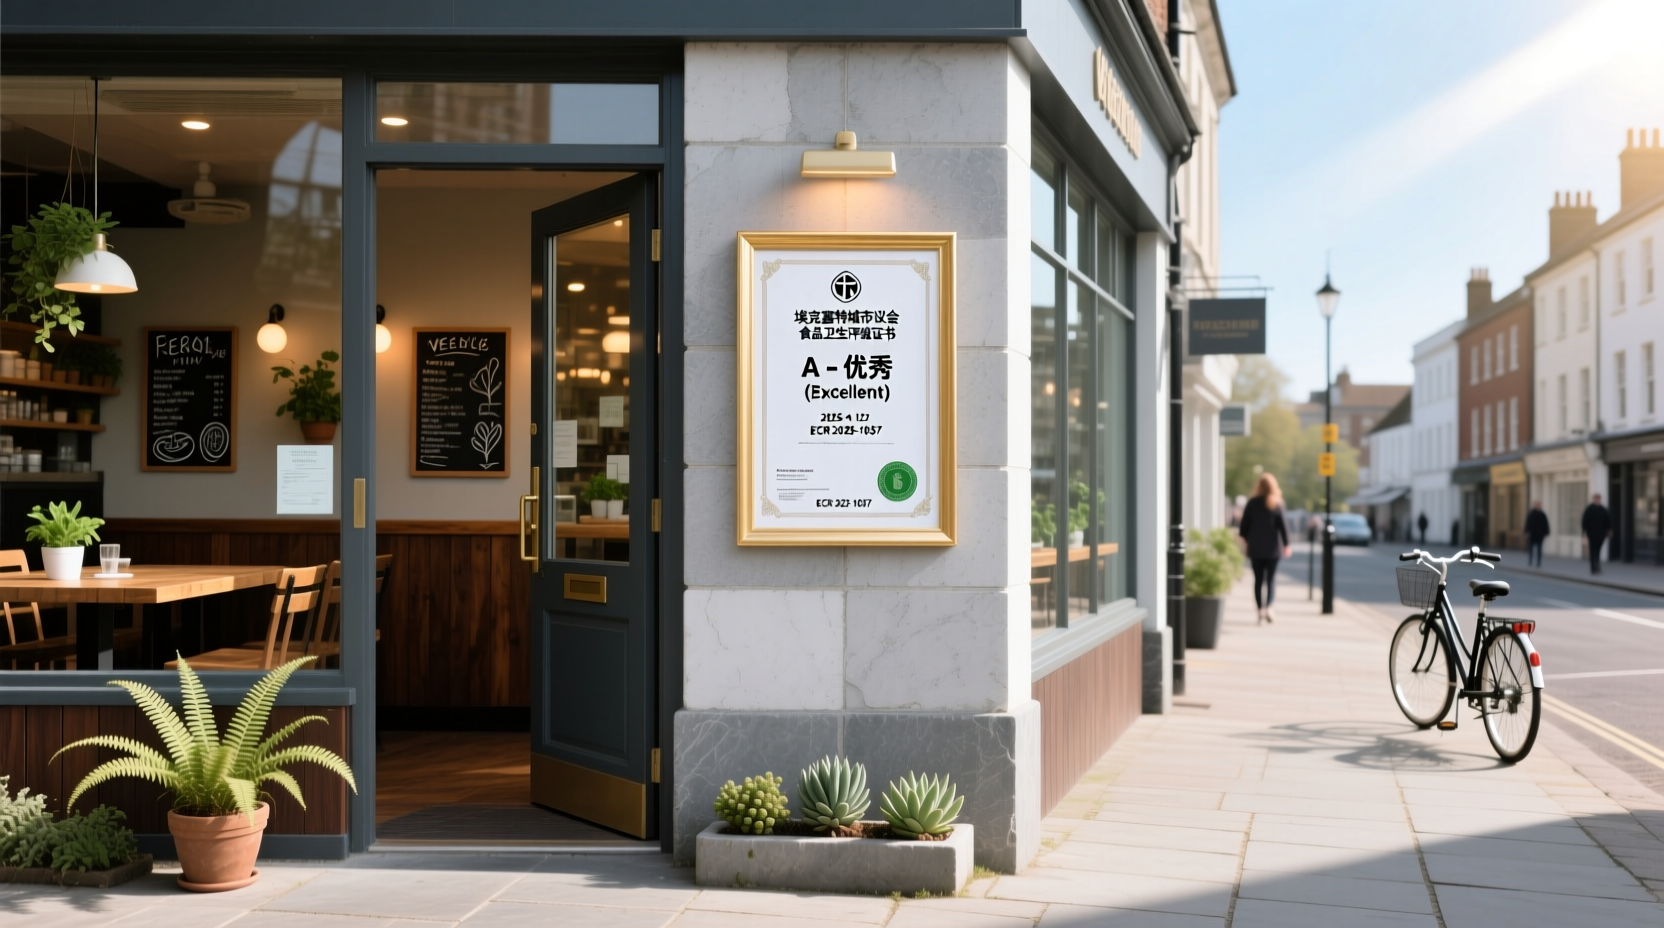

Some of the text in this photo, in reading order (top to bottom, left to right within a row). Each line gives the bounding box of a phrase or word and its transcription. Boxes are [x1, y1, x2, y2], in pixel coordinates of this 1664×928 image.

[801, 356, 820, 378] A
[843, 354, 893, 380] 优秀
[804, 383, 890, 403] (Excellent)
[810, 425, 831, 436] ECR
